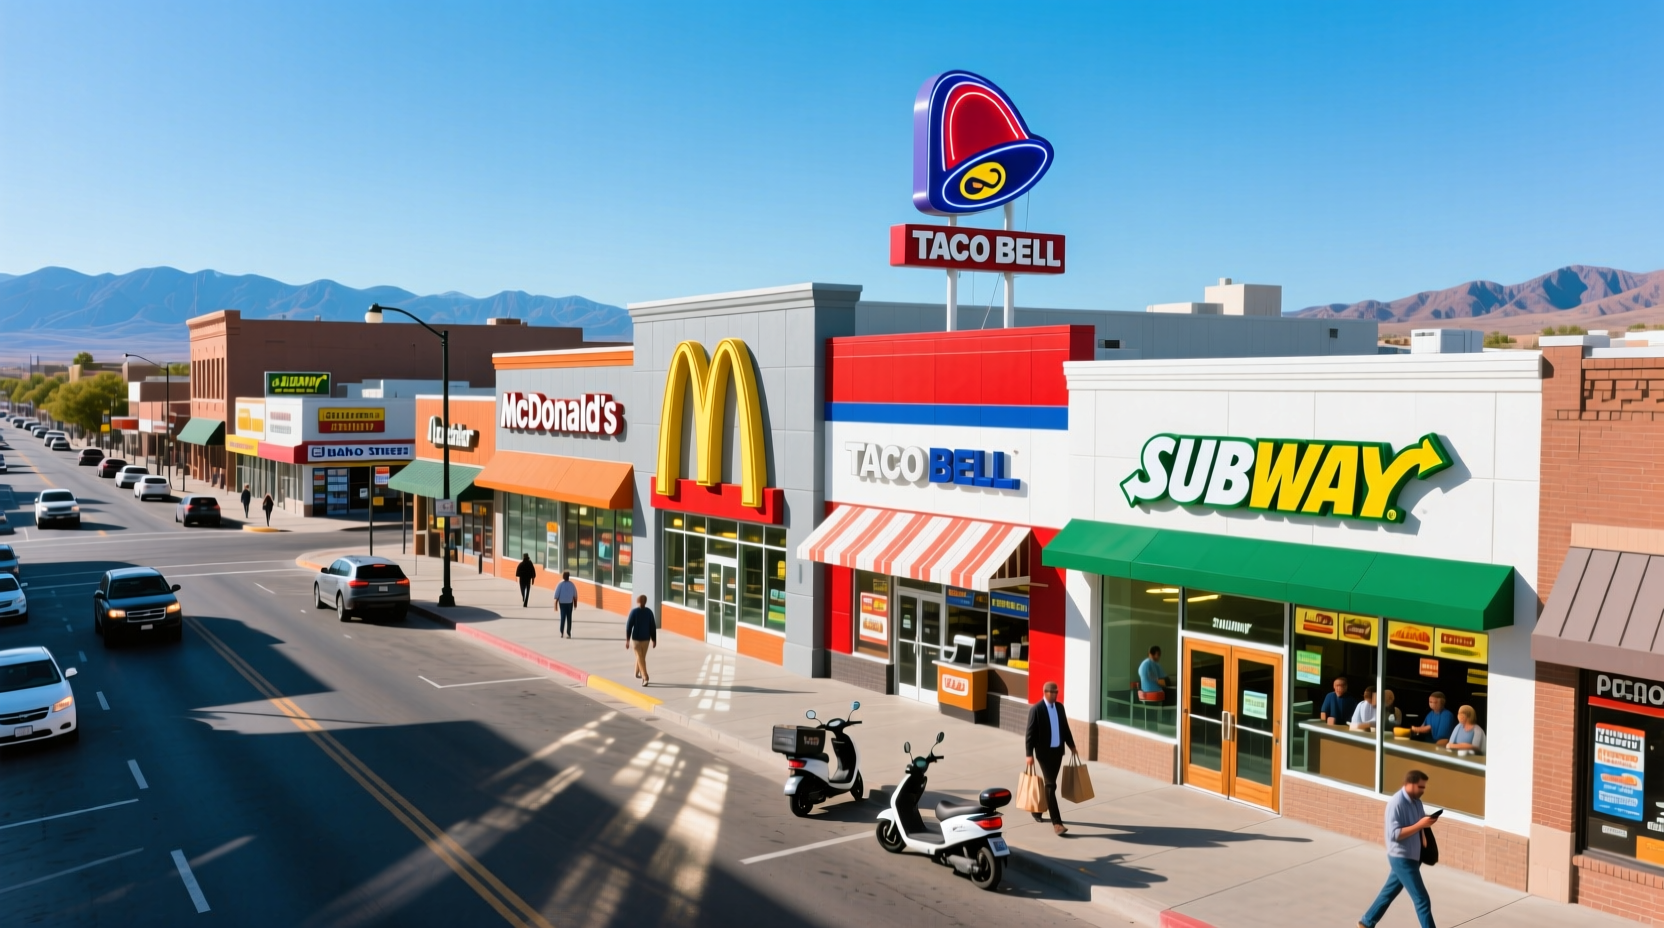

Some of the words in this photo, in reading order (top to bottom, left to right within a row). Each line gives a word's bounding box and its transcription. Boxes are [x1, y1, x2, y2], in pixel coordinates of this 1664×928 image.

[912, 229, 990, 263] TACO
[995, 236, 1061, 267] BELL
[501, 392, 620, 435] McDonald's
[845, 441, 926, 482] TACO
[929, 447, 1020, 490] BELL
[1121, 433, 1452, 521] SUBWAY
